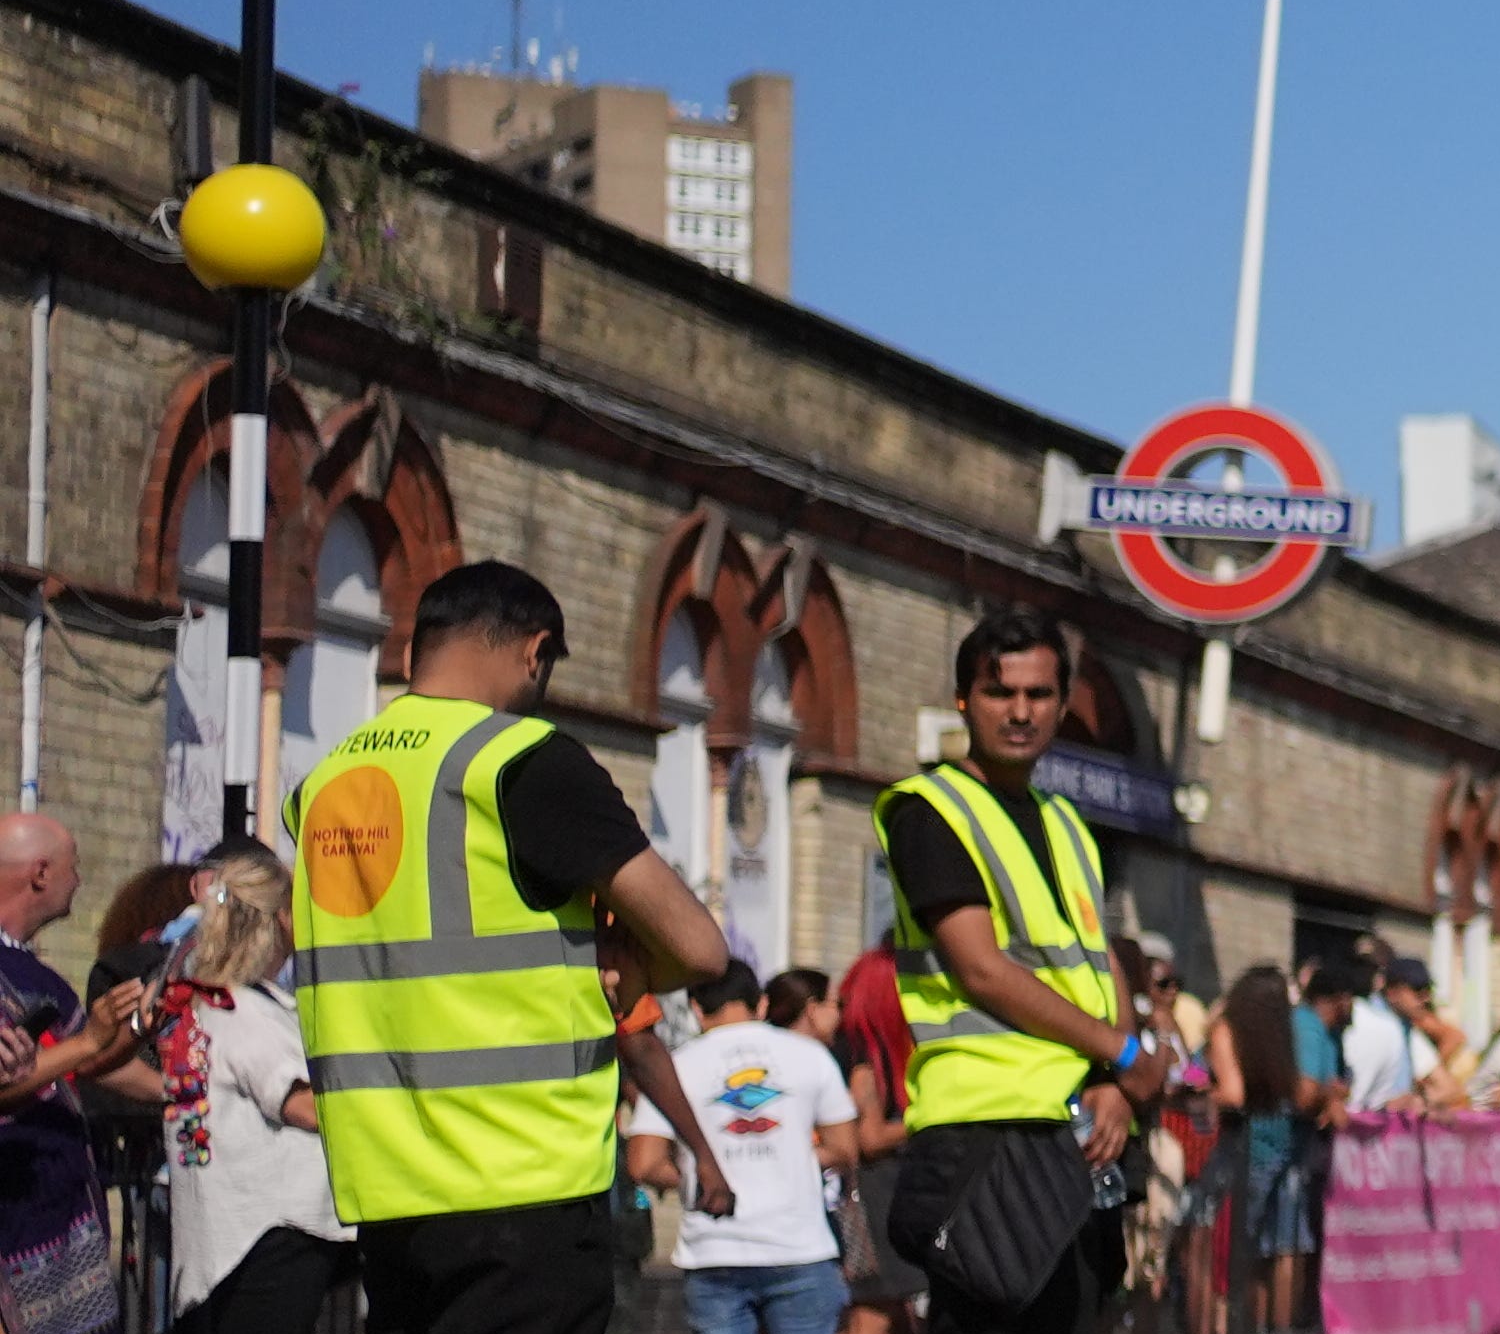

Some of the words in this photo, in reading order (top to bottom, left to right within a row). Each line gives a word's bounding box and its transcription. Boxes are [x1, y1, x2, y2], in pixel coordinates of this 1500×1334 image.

[1097, 489, 1345, 534] UNDERGROUND
[329, 729, 431, 757] TEWARD
[313, 827, 364, 841] NOTTING
[367, 827, 389, 840] HILL
[322, 843, 376, 857] CARNIVAL
